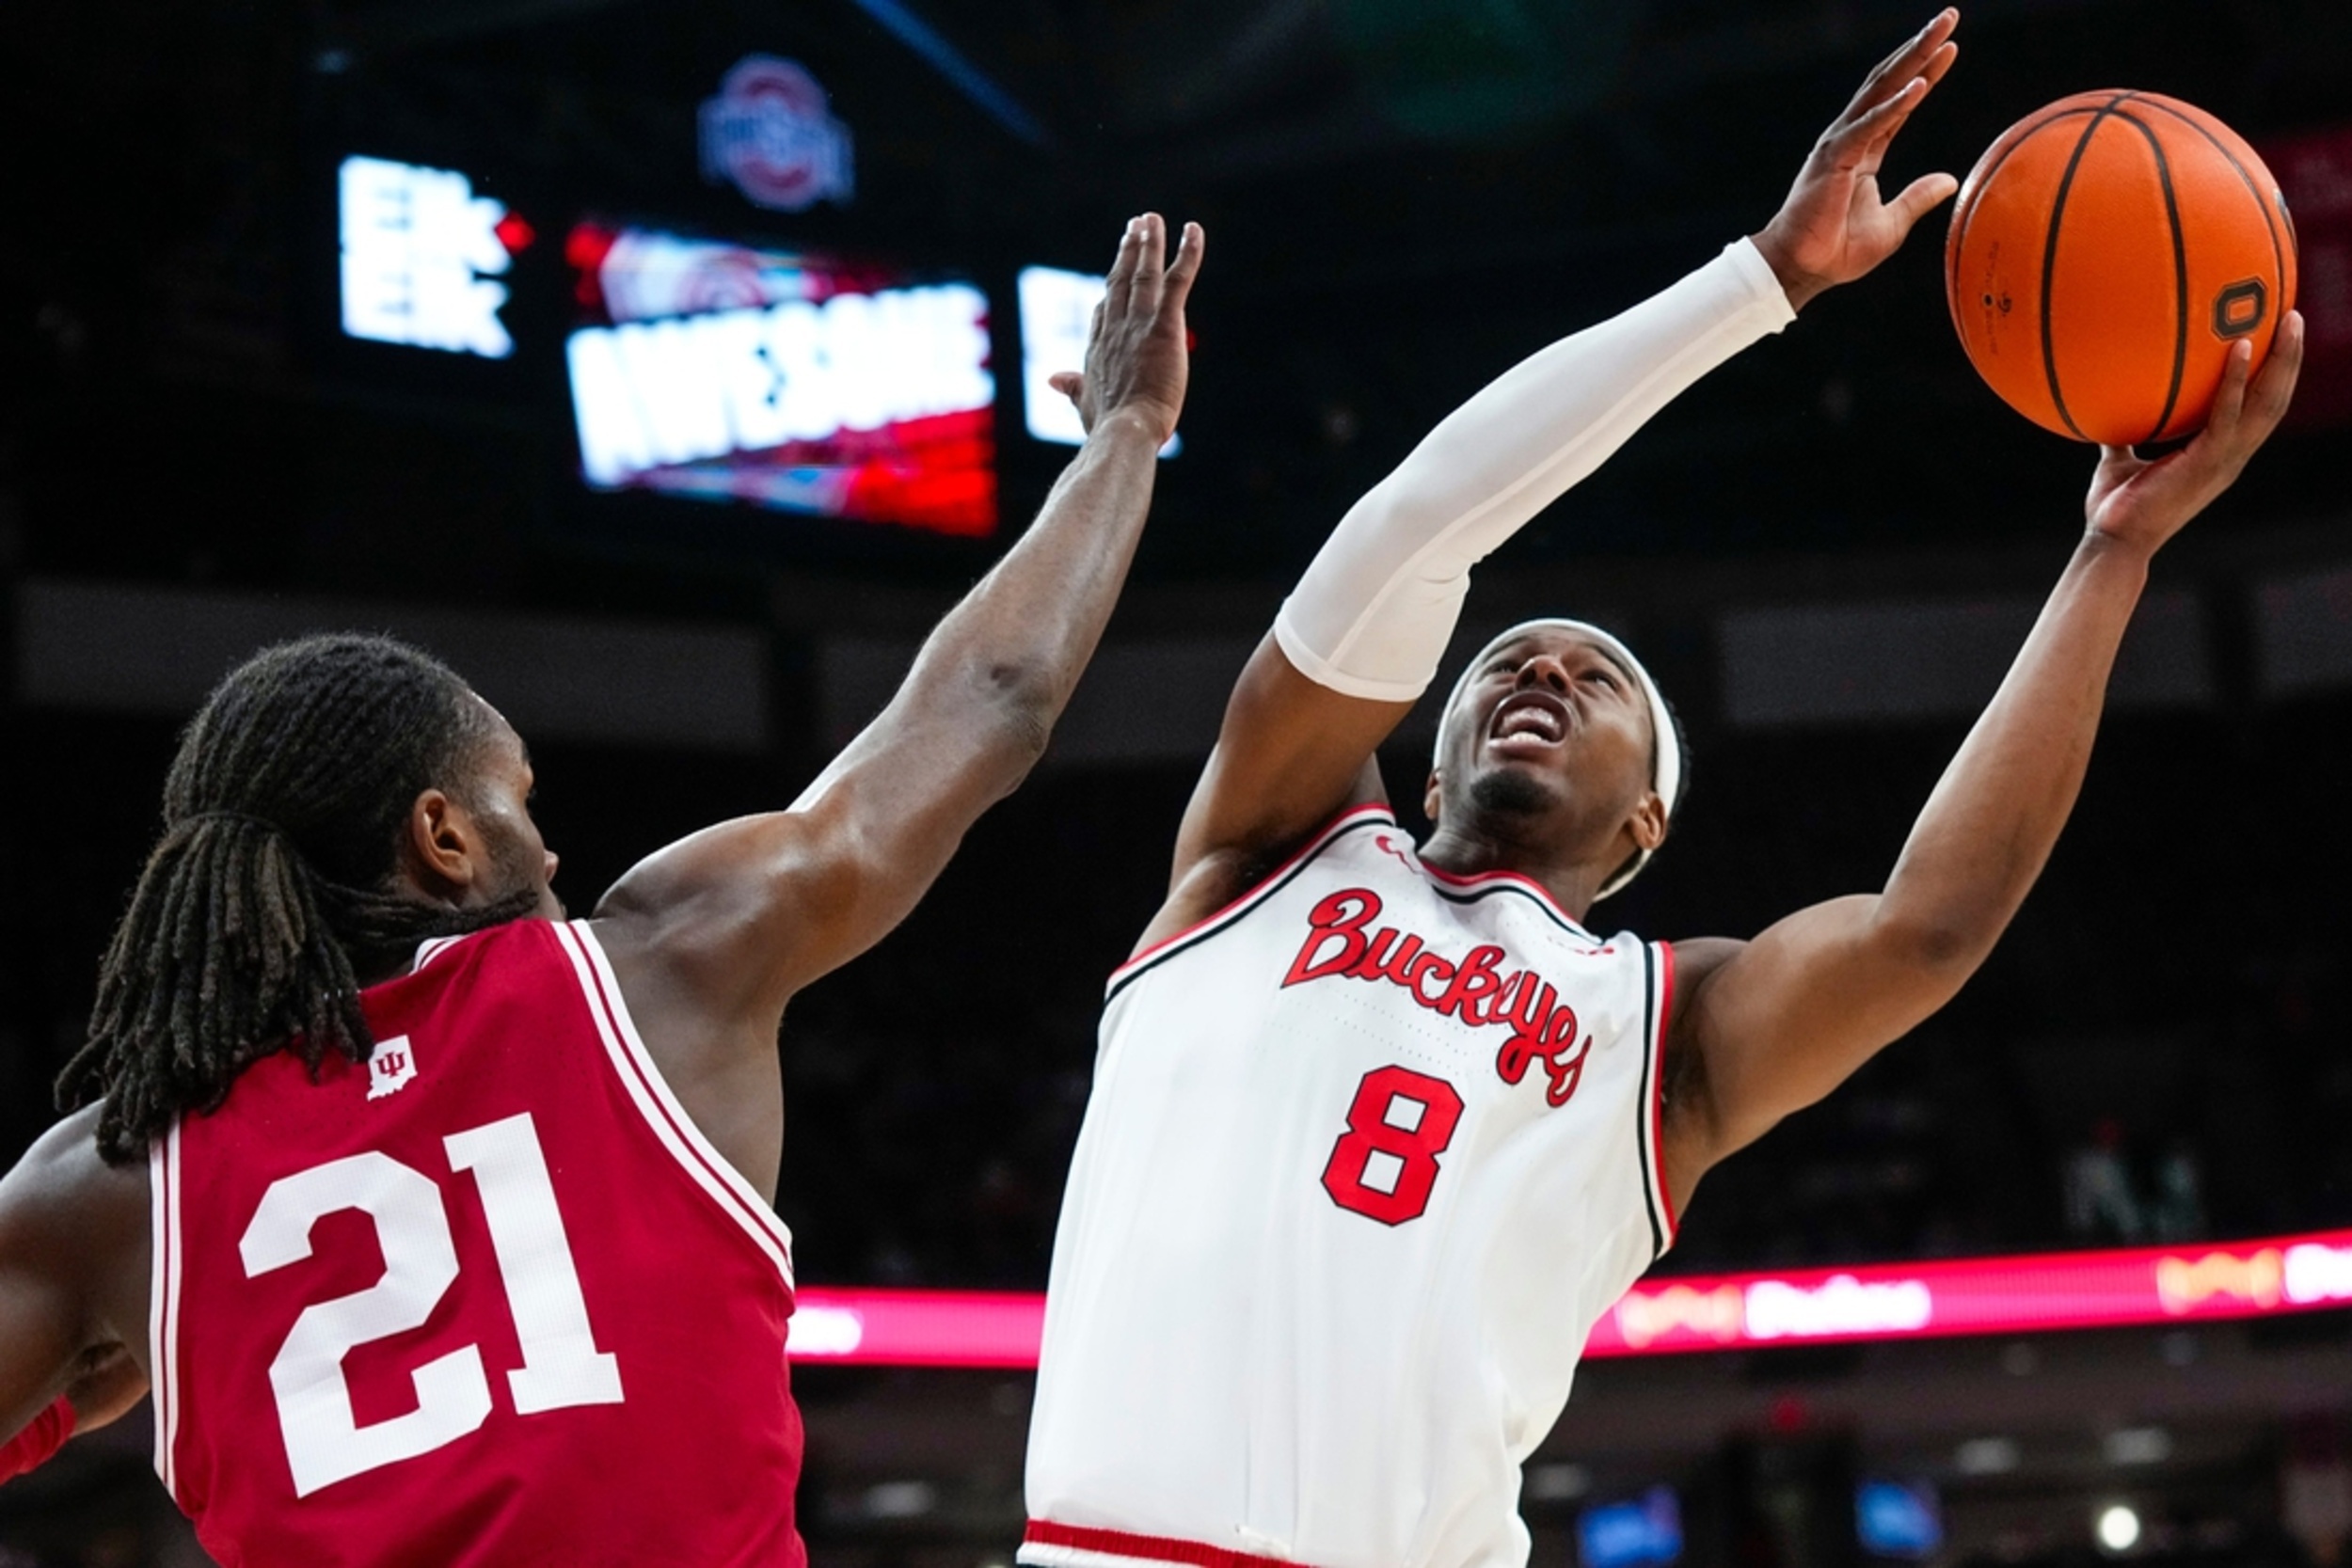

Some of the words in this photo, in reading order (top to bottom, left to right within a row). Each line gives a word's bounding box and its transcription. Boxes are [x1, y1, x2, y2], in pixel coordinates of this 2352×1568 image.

[1280, 888, 1592, 1107] Buckeyes
[1320, 1065, 1465, 1227] 8
[238, 1112, 625, 1498] 21
